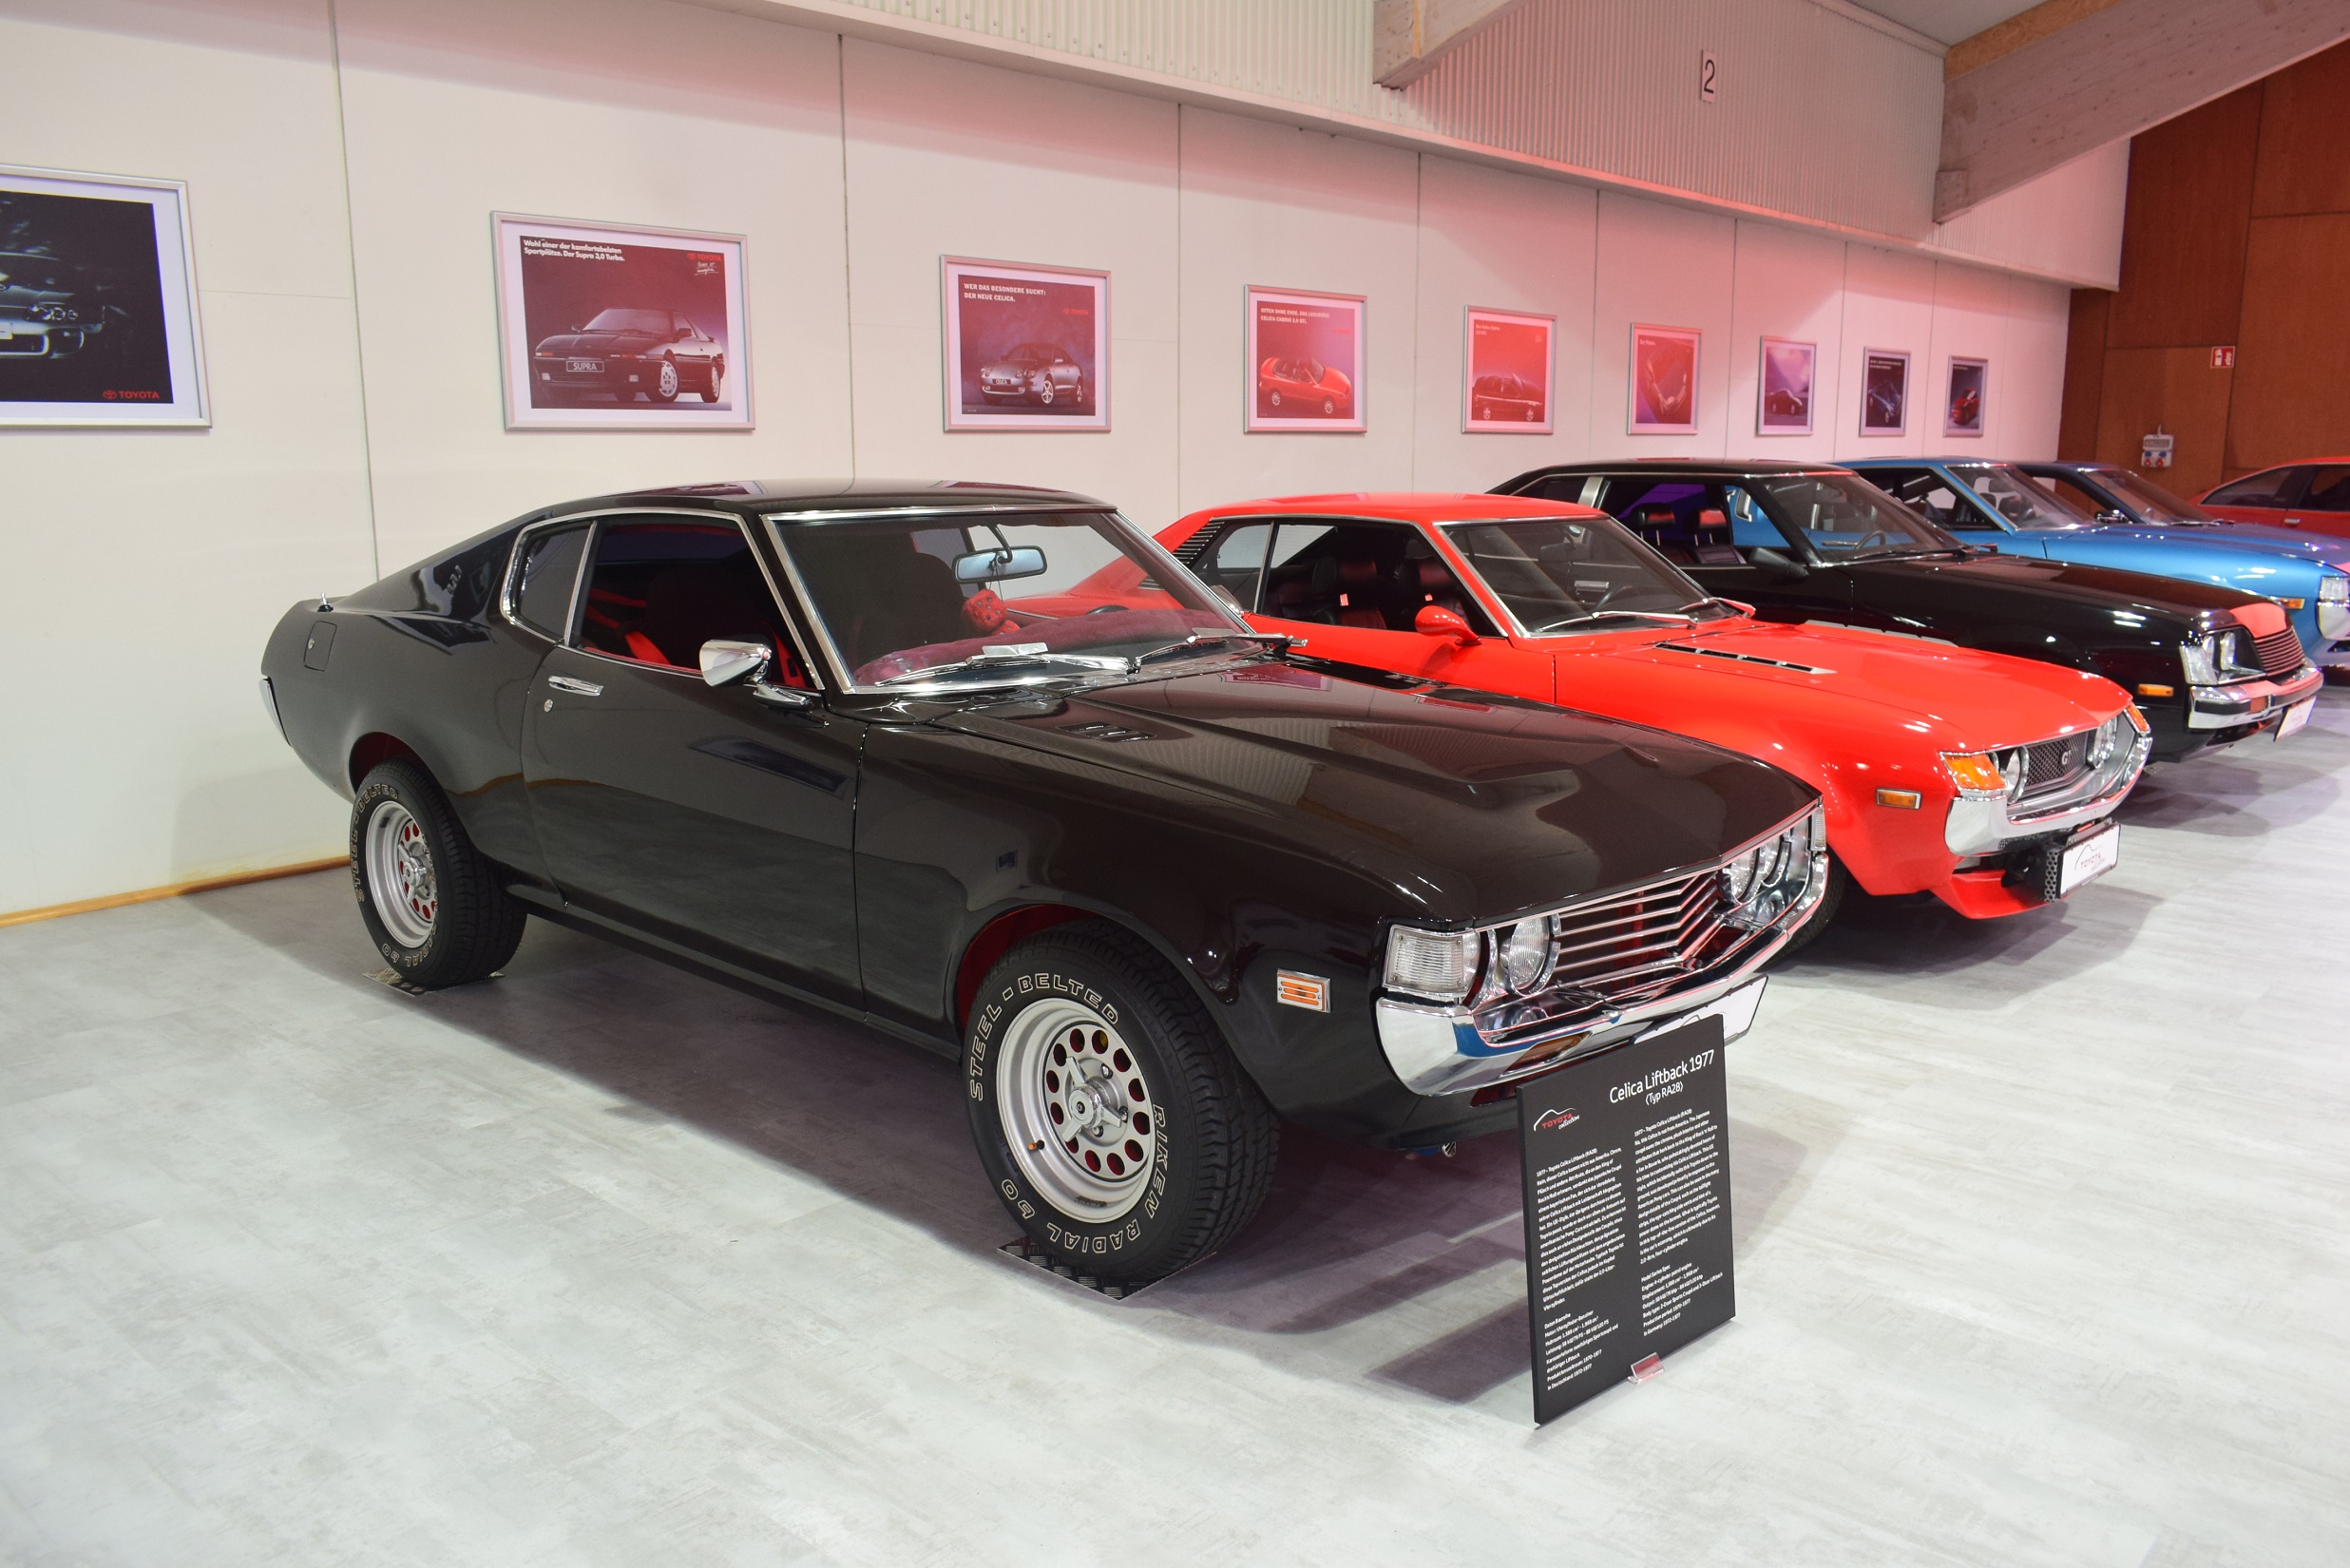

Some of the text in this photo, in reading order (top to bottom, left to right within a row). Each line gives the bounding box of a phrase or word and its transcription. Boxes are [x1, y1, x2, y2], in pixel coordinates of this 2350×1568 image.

[1704, 59, 1715, 94] 2
[575, 252, 594, 260] Supra
[697, 254, 722, 262] TOYOTA
[991, 285, 1025, 294] BESONDERE
[573, 362, 597, 370] SUPRA
[119, 391, 160, 399] TOYOTA
[1609, 1049, 1714, 1103] Celica Liftback 1977
[1645, 1081, 1683, 1105] (Typ RA28)
[1542, 1113, 1573, 1129] TOYOTA
[1144, 1103, 1169, 1221] RIKEN
[1046, 1218, 1141, 1254] RADIAL
